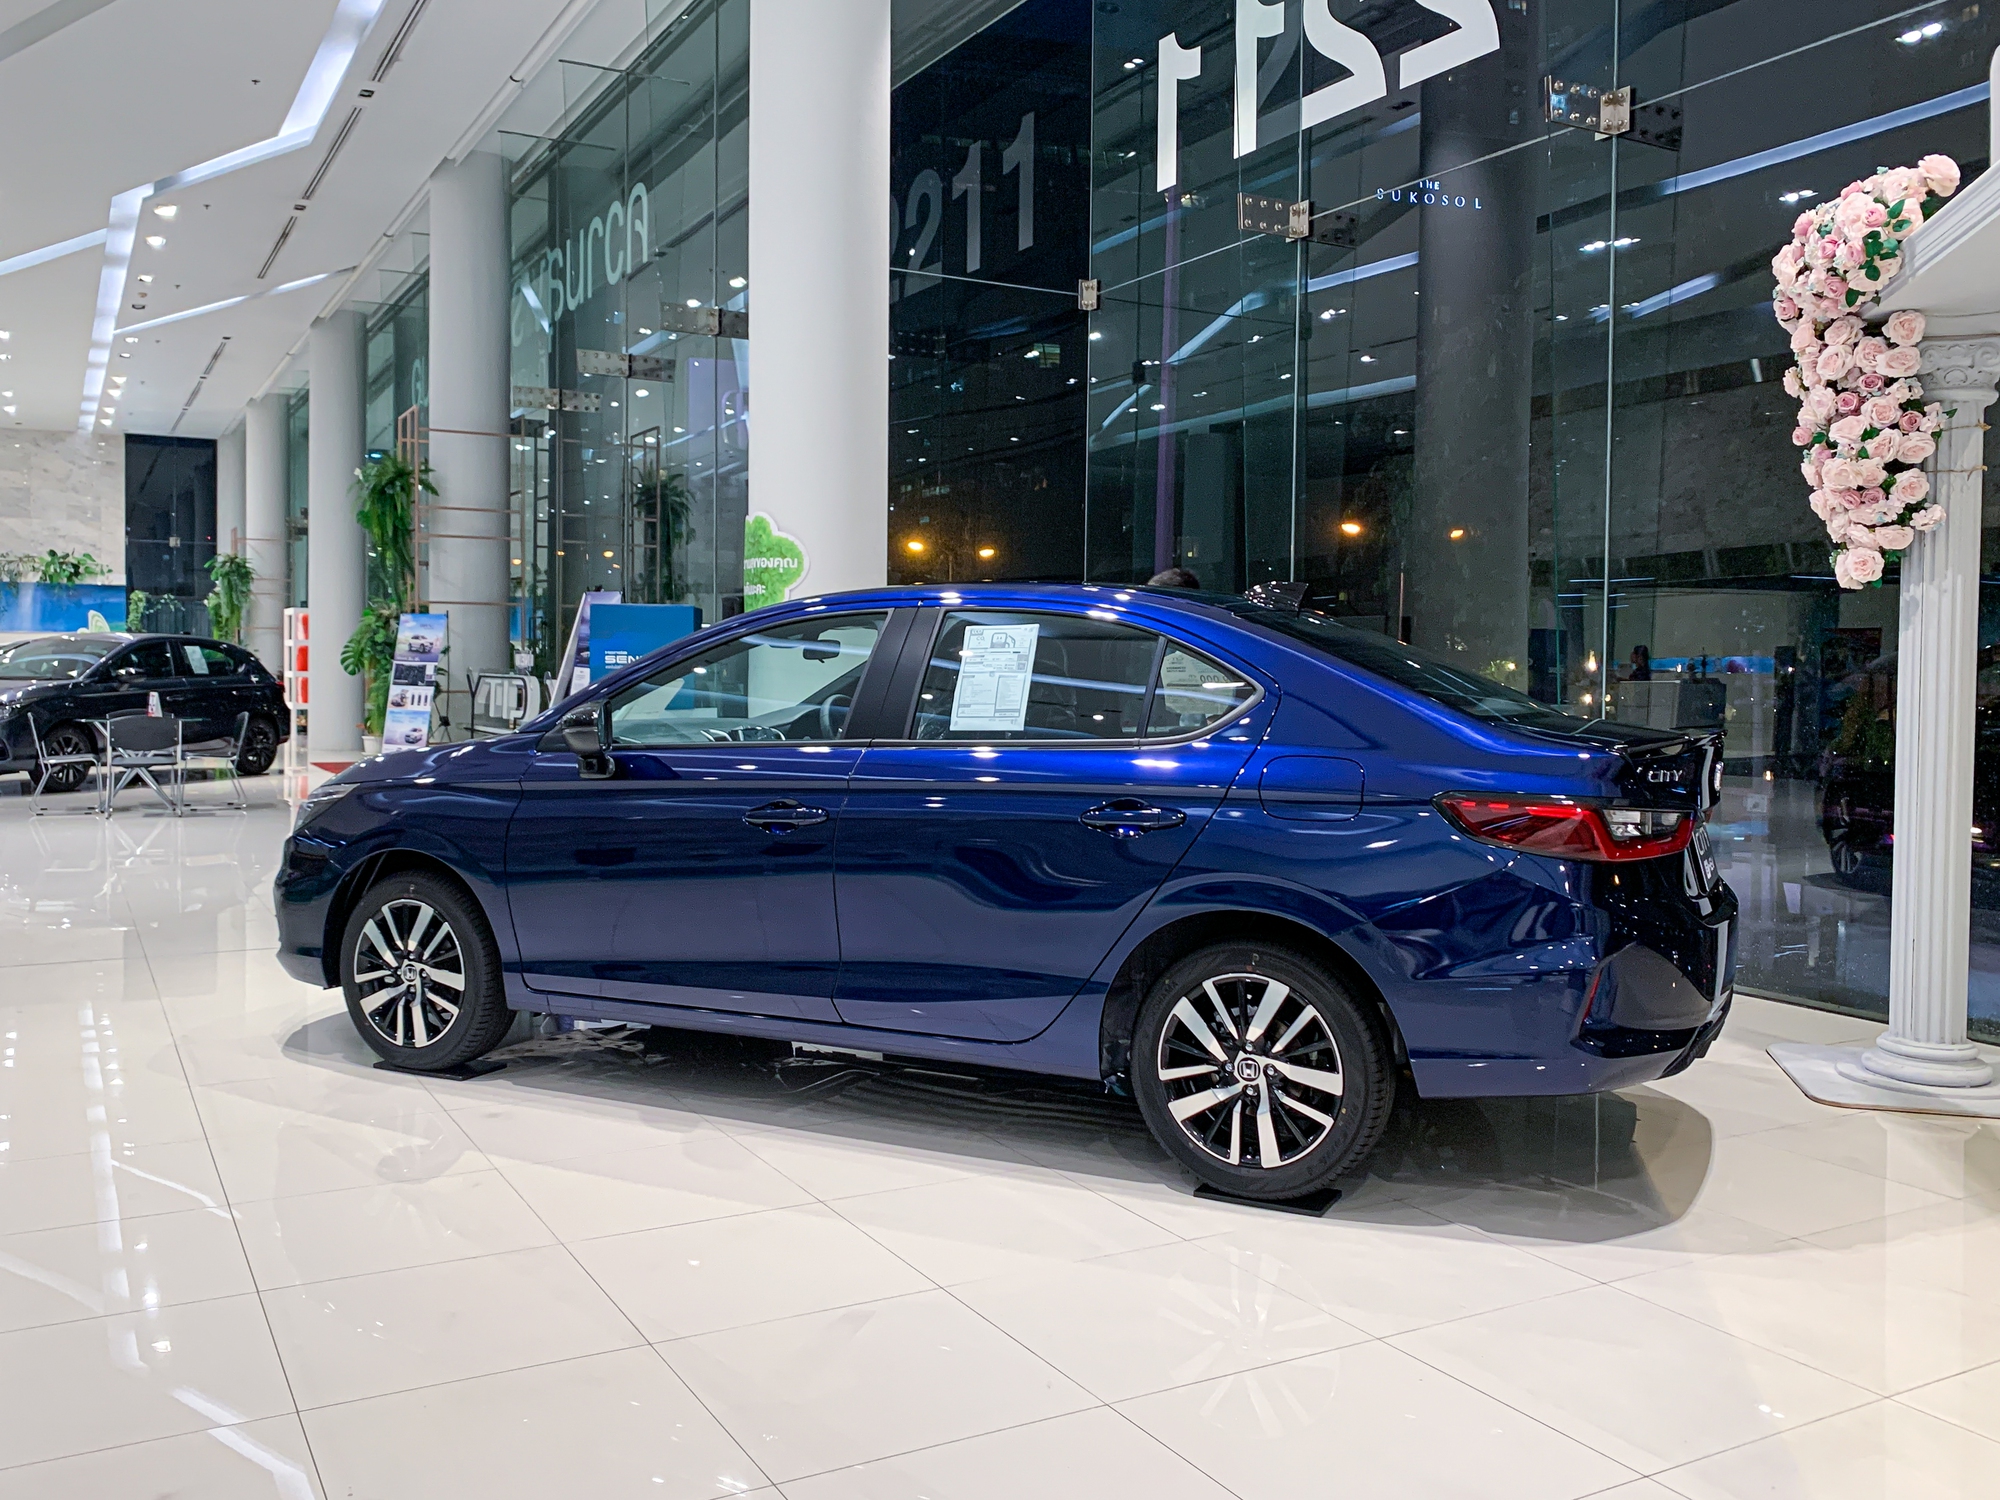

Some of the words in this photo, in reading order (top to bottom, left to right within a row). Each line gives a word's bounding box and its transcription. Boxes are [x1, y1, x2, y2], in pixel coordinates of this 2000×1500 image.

[1419, 179, 1440, 190] THE
[1377, 187, 1482, 209] SUKOSOL
[604, 655, 643, 664] SEN
[1648, 769, 1683, 783] CITY
